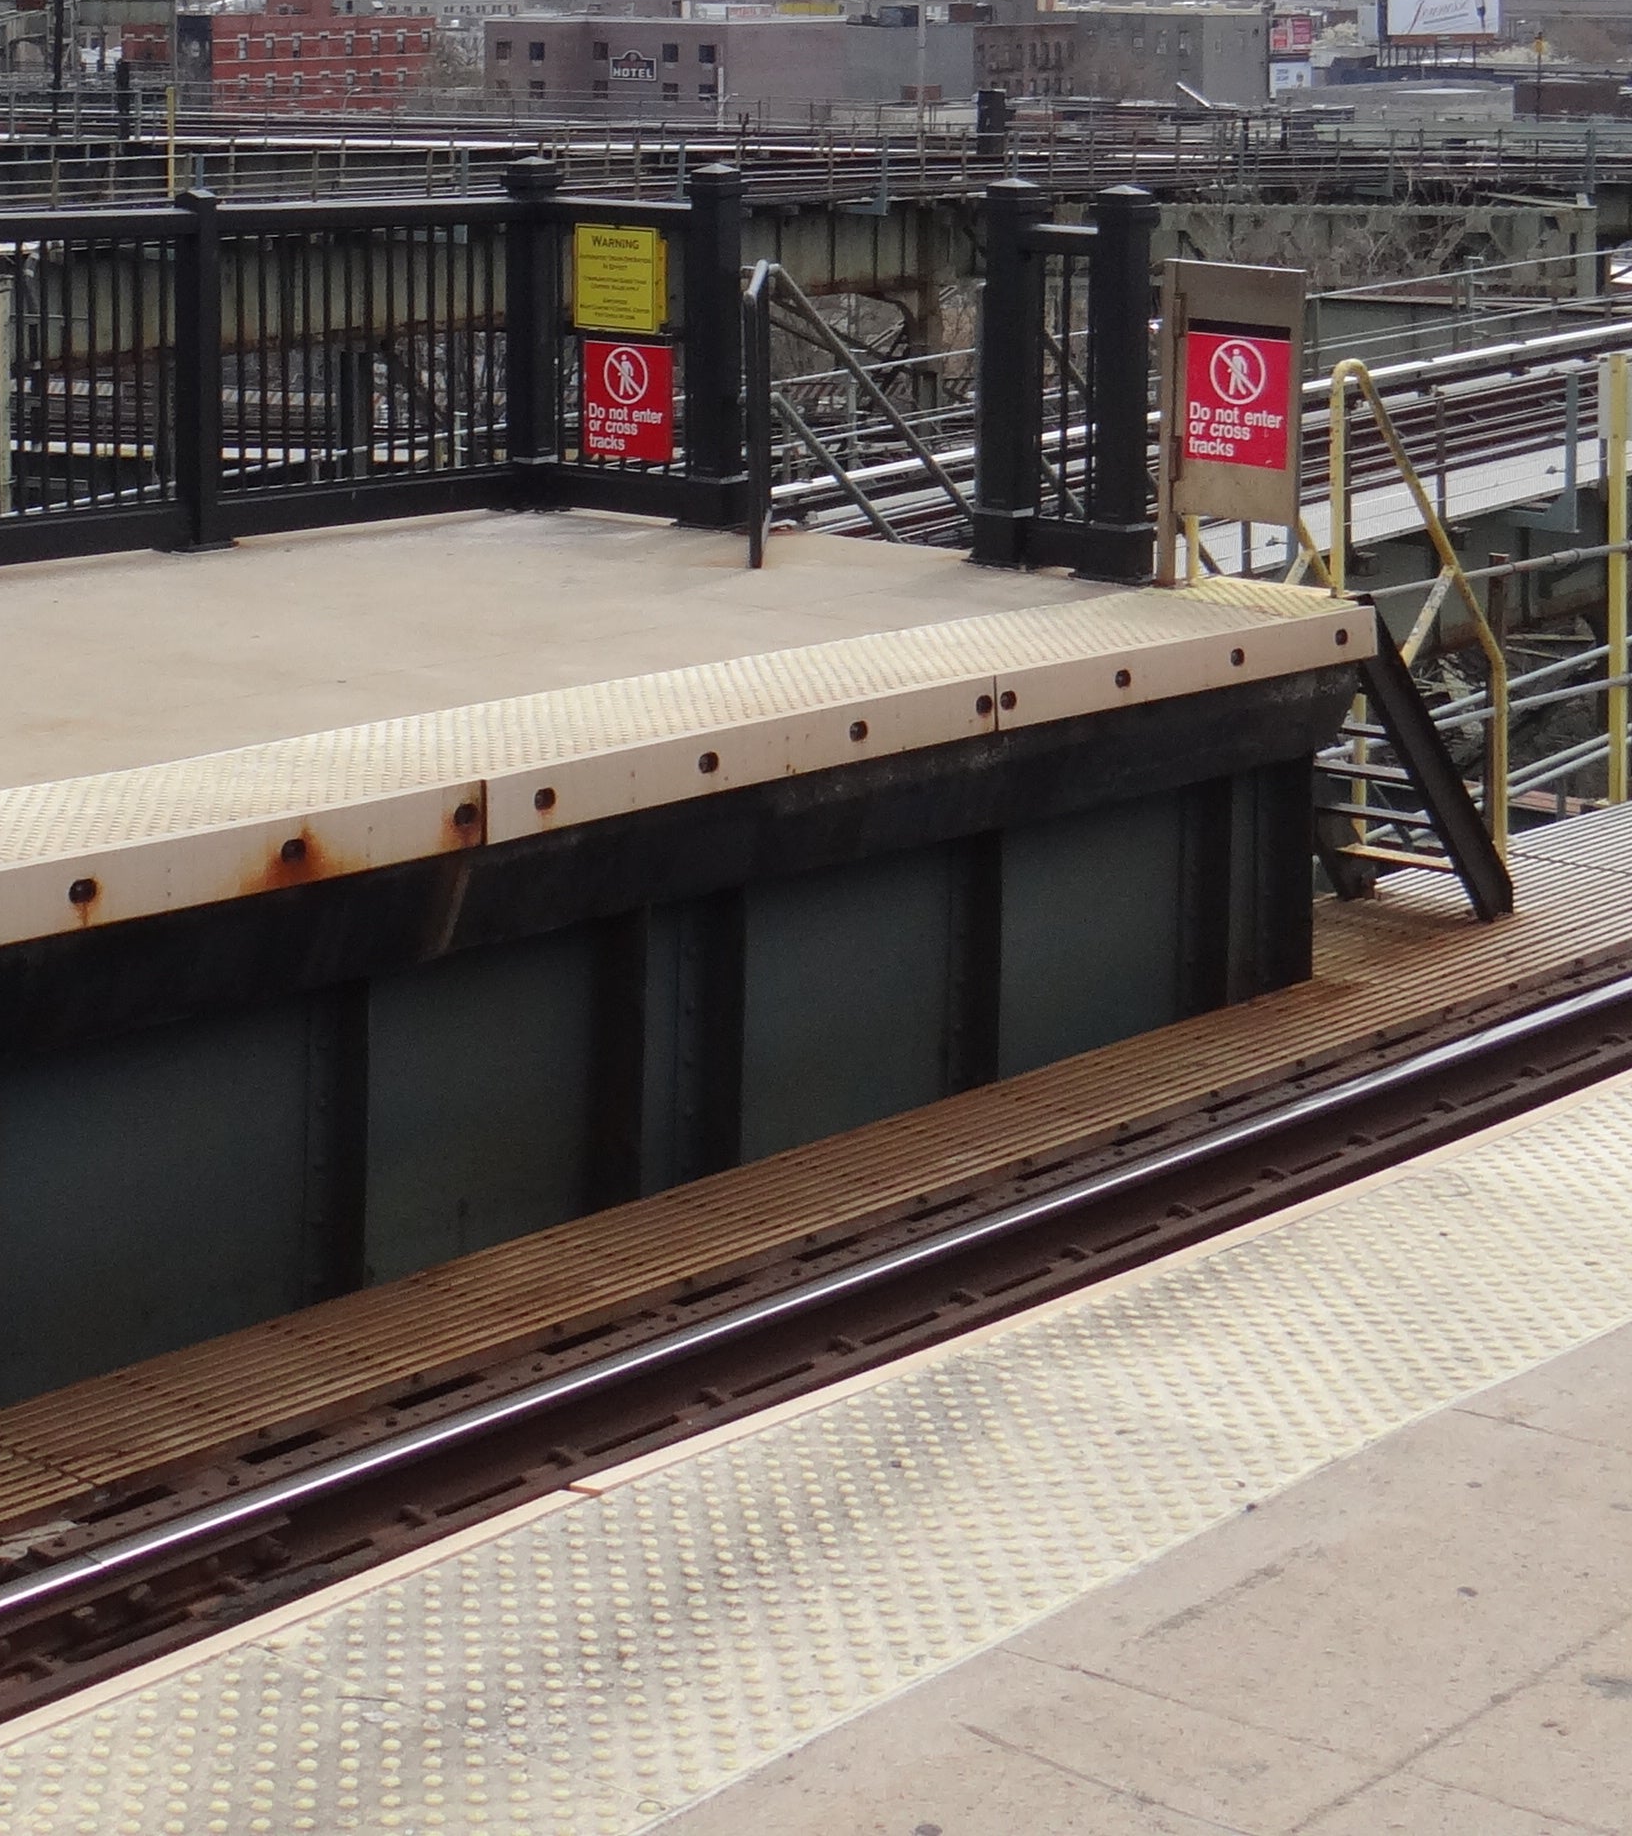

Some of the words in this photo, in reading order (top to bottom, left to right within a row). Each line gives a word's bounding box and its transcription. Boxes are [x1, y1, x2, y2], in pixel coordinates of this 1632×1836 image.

[613, 68, 653, 78] HOTEL
[591, 236, 640, 250] WARNING
[588, 402, 605, 419] Do
[609, 406, 628, 421] not
[632, 409, 663, 424] enter
[1189, 401, 1210, 420] Do
[1215, 407, 1239, 423] not
[1244, 410, 1283, 429] enter
[589, 419, 601, 432] or
[605, 420, 638, 436] cross
[1189, 421, 1206, 435] or
[1210, 422, 1250, 440] cross
[589, 433, 625, 451] tracks
[1189, 437, 1234, 457] tracks
